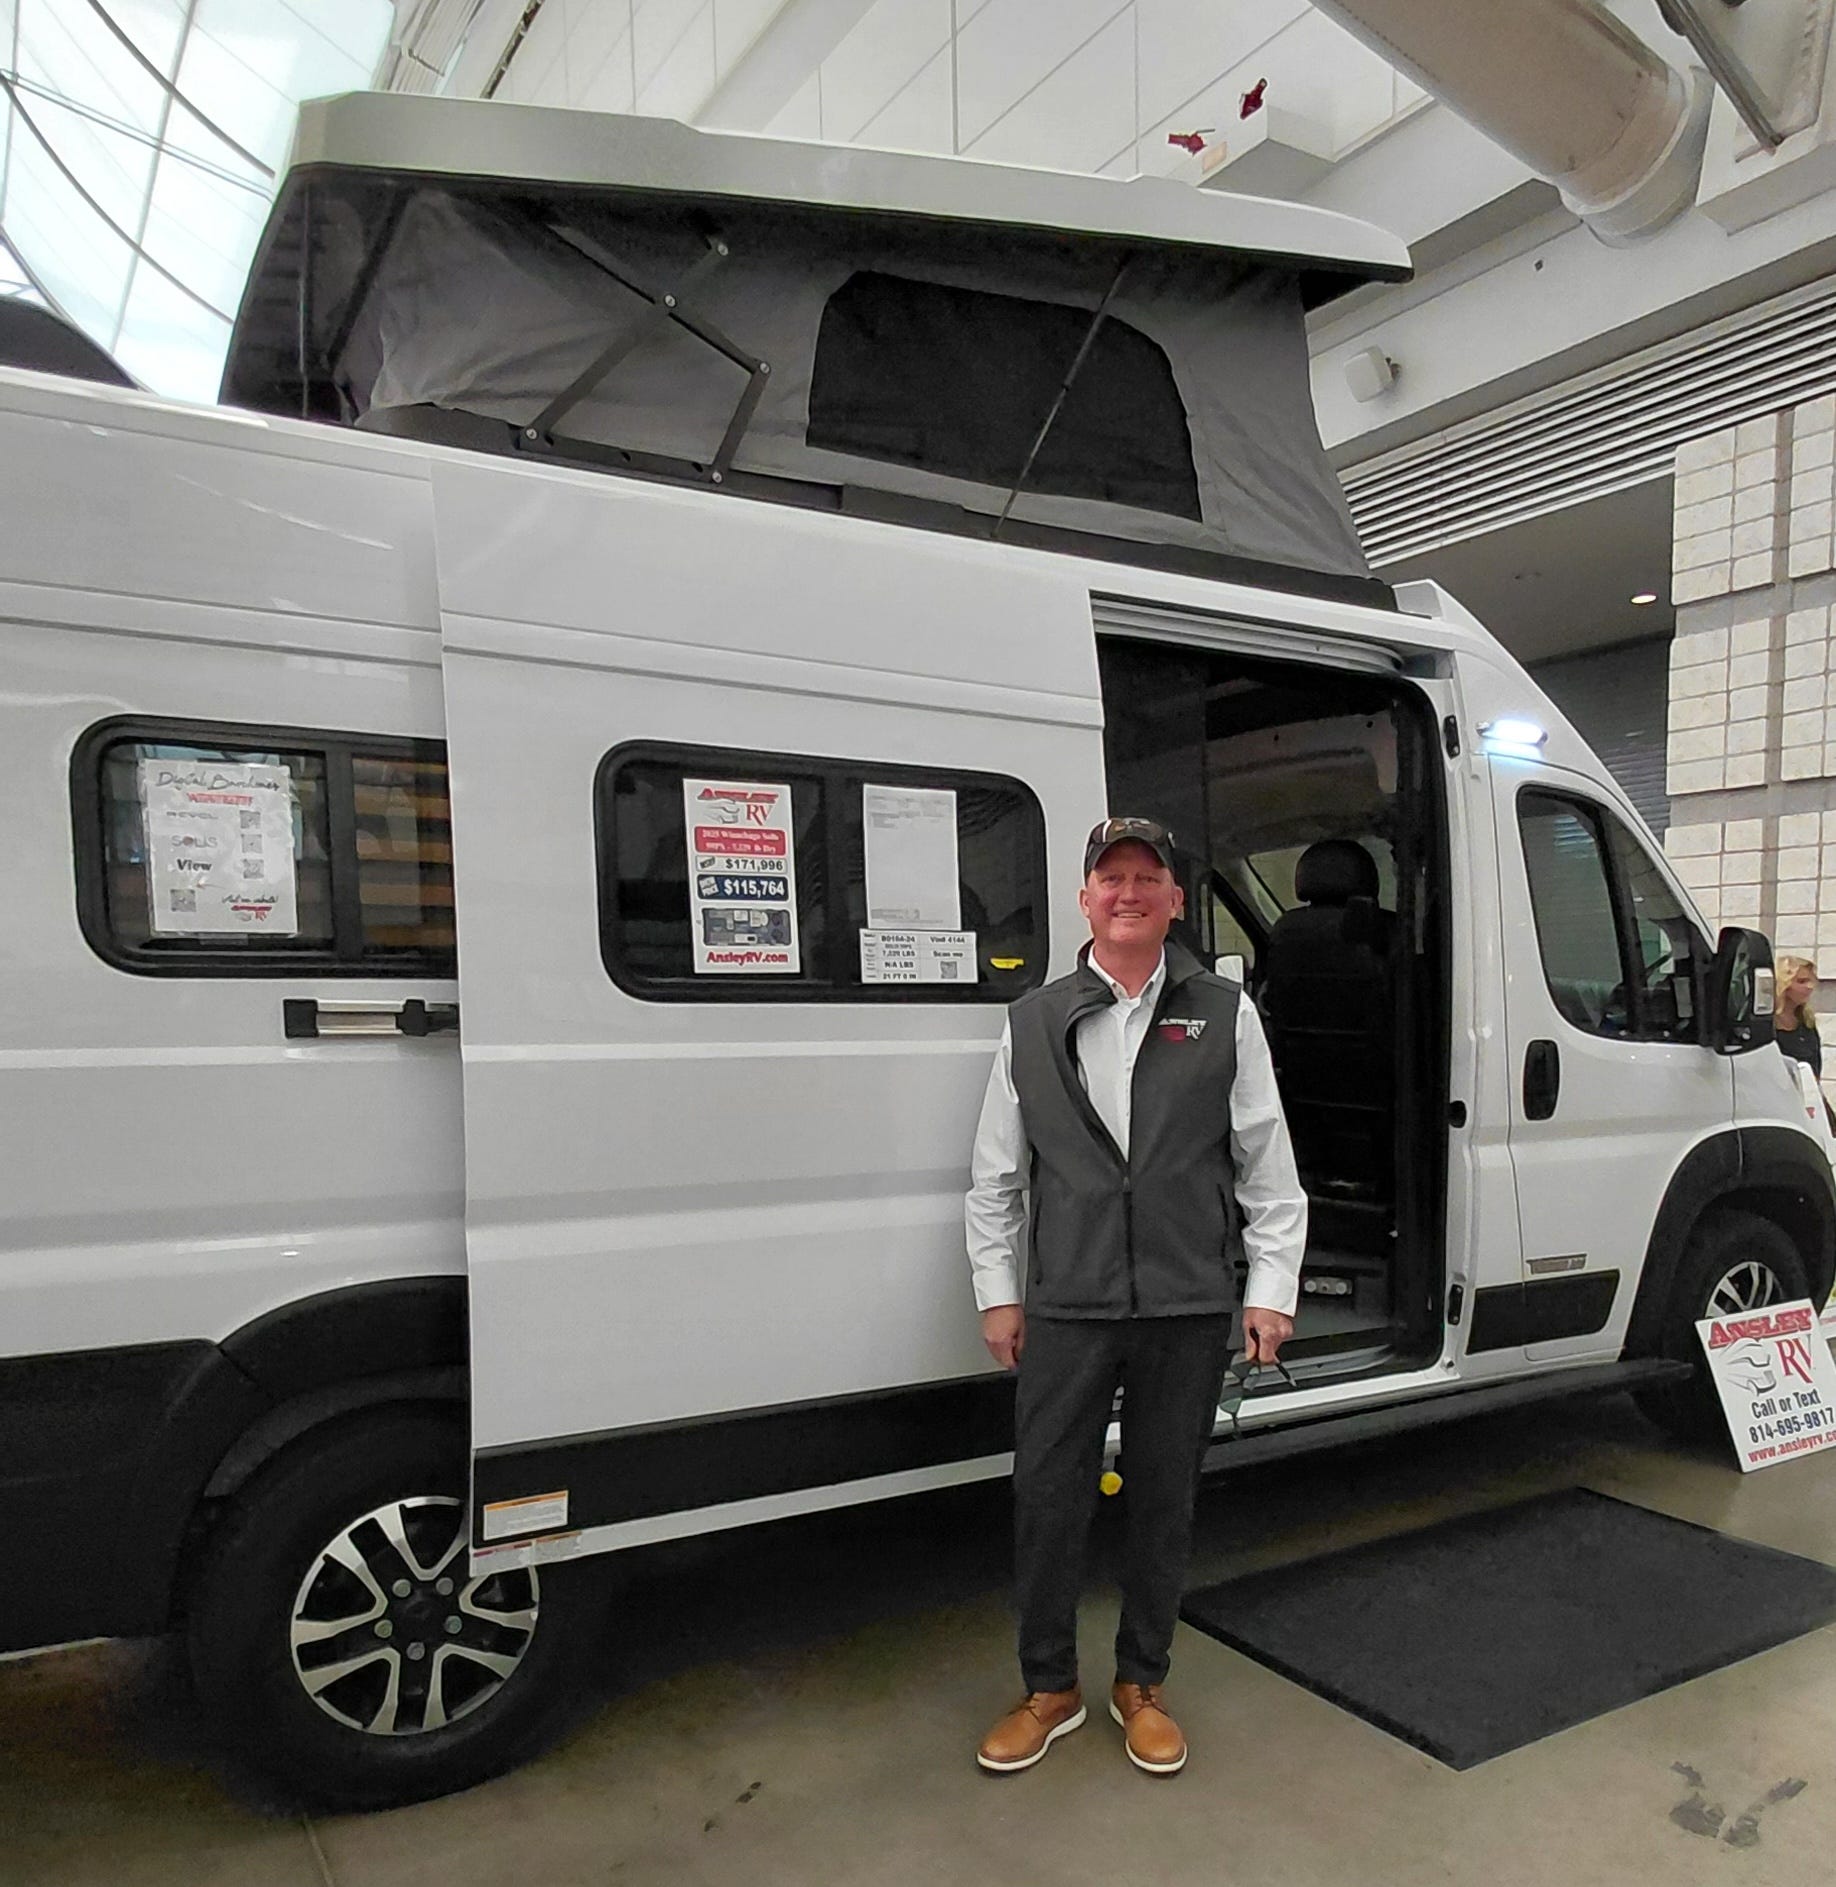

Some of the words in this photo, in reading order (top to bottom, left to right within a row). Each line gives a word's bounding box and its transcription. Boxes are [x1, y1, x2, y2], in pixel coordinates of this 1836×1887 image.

[745, 803, 774, 826] RV
[176, 858, 213, 871] View
[725, 858, 784, 872] $171,996
[723, 878, 785, 898] $115,764
[706, 951, 789, 966] AnsleyRV.com
[1186, 1025, 1205, 1040] RV
[1708, 1307, 1813, 1350] ANSLEY
[1775, 1334, 1814, 1384] RV
[1751, 1398, 1777, 1419] Call
[1780, 1395, 1792, 1411] or
[1793, 1388, 1822, 1407] Text
[1748, 1407, 1835, 1444] 814-695-9817
